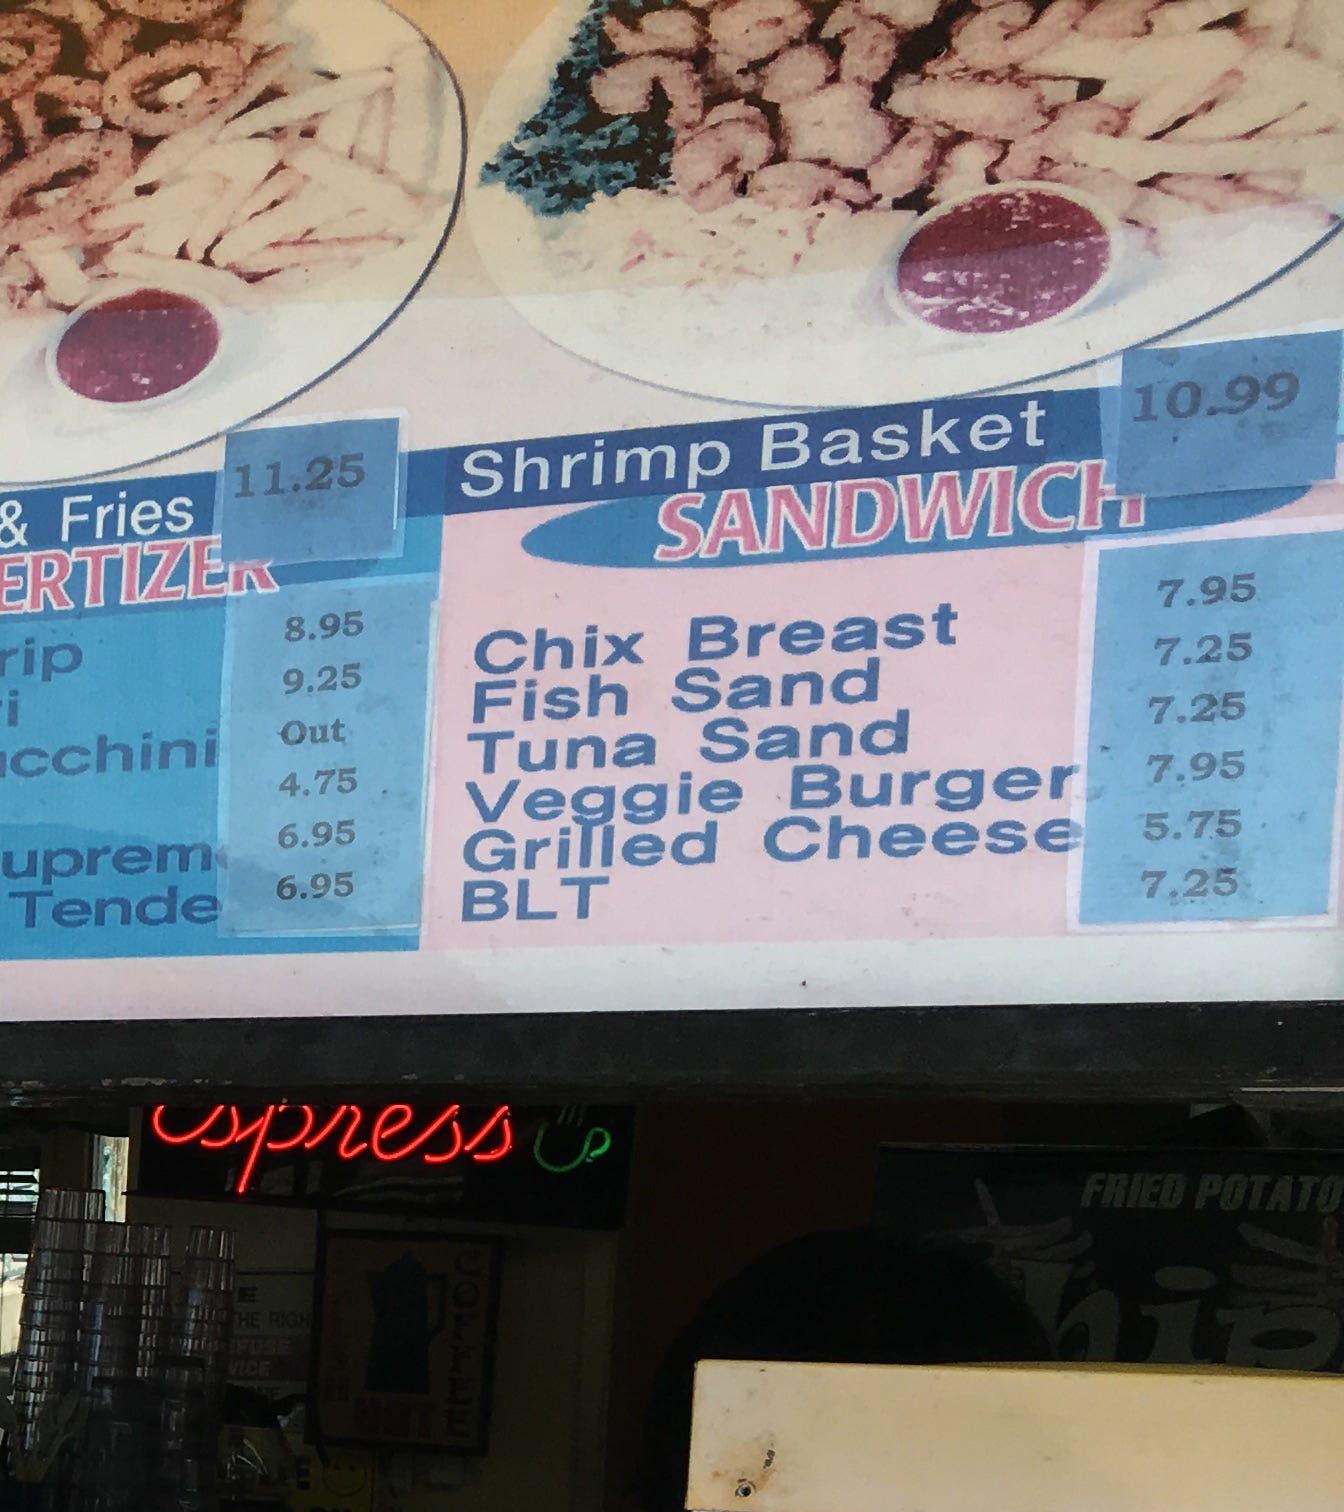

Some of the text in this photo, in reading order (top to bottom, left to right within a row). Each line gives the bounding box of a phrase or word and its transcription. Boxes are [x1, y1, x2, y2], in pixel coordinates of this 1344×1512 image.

[1130, 371, 1300, 425] 10.99
[459, 399, 1048, 500] Shrimp Basket
[234, 452, 366, 499] 11.25
[60, 492, 194, 543] Fries
[654, 460, 1146, 561] SANDWICH
[1156, 572, 1257, 609] 7.95
[284, 611, 366, 642] 8.95
[473, 601, 960, 677] Chix Breast
[1152, 632, 1254, 668] 7.25
[282, 664, 363, 695] 9.25
[472, 656, 880, 725] Fish Sand
[1147, 691, 1247, 726] 7.25
[277, 718, 347, 748] Out
[468, 708, 911, 775] Tuna Sand
[278, 768, 358, 798] 4.75
[1145, 749, 1246, 785] 7.95
[466, 762, 1081, 826] Veggie Burger
[277, 819, 356, 849] 6.95
[1142, 807, 1243, 841] 5.75
[462, 815, 1084, 874] Grilled Cheese
[276, 871, 355, 900] 6.95
[462, 876, 610, 923] BLT
[1139, 867, 1240, 901] 7.25
[1080, 1171, 1188, 1210] FRIED
